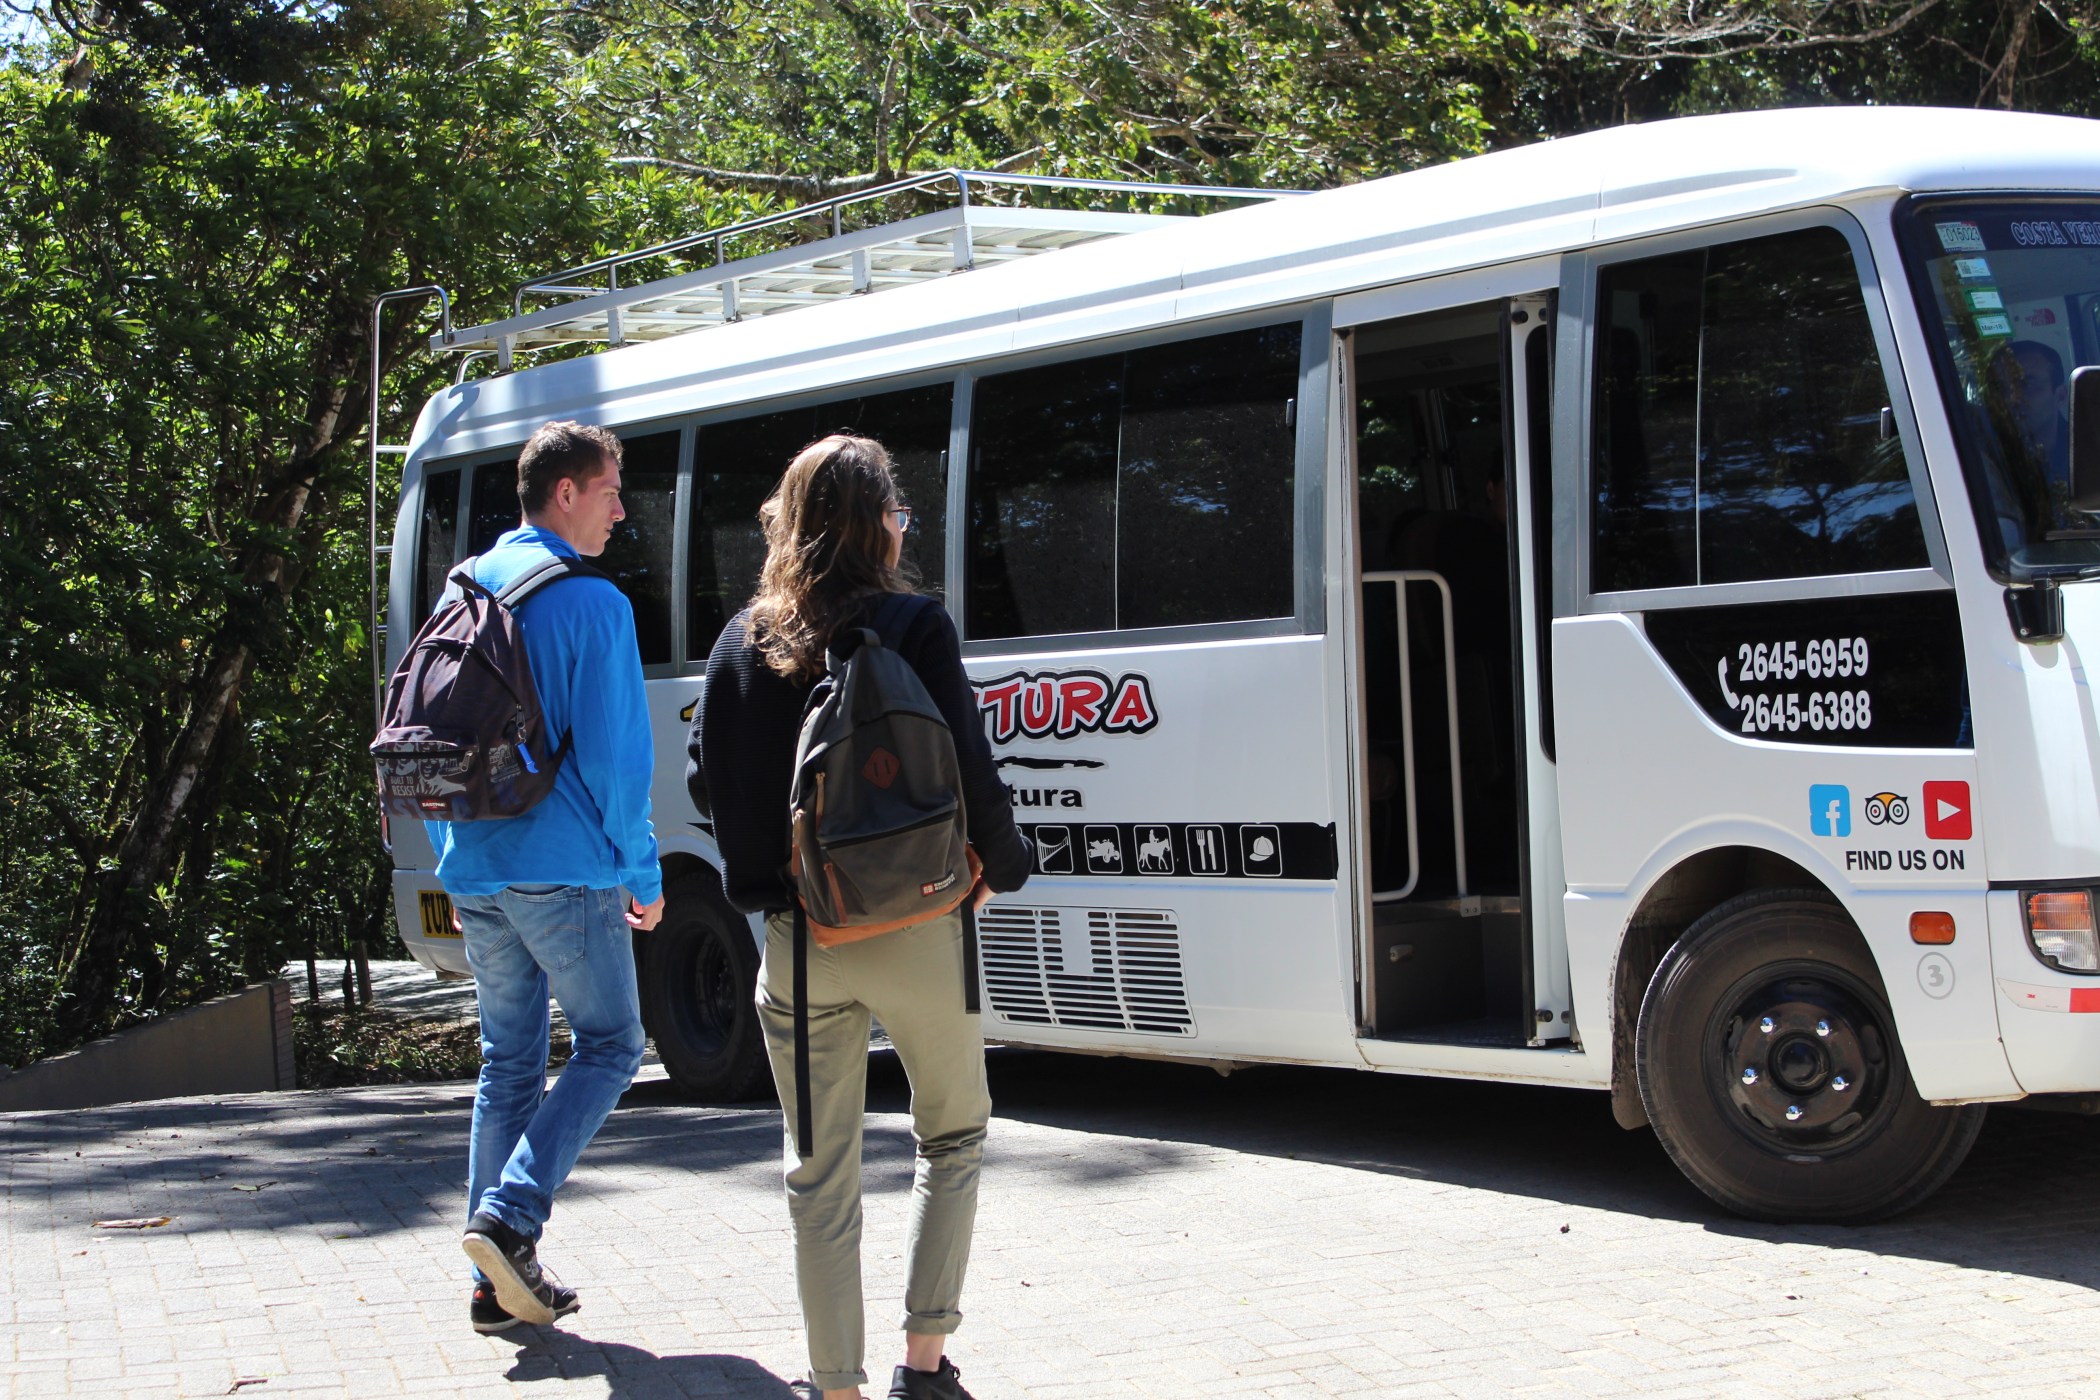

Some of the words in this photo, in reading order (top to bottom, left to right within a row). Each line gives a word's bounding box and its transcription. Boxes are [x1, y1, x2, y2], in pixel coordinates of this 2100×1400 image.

[2010, 221, 2068, 245] COSTA
[1738, 636, 1869, 682] 2645-6959
[968, 670, 1157, 744] TURA
[1739, 690, 1872, 733] 2645-6388
[391, 785, 416, 797] RESIST
[1845, 850, 1892, 871] FIND
[1898, 849, 1927, 870] US
[1932, 849, 1965, 871] ON
[420, 893, 463, 935] TUR
[1927, 964, 1944, 988] 3
